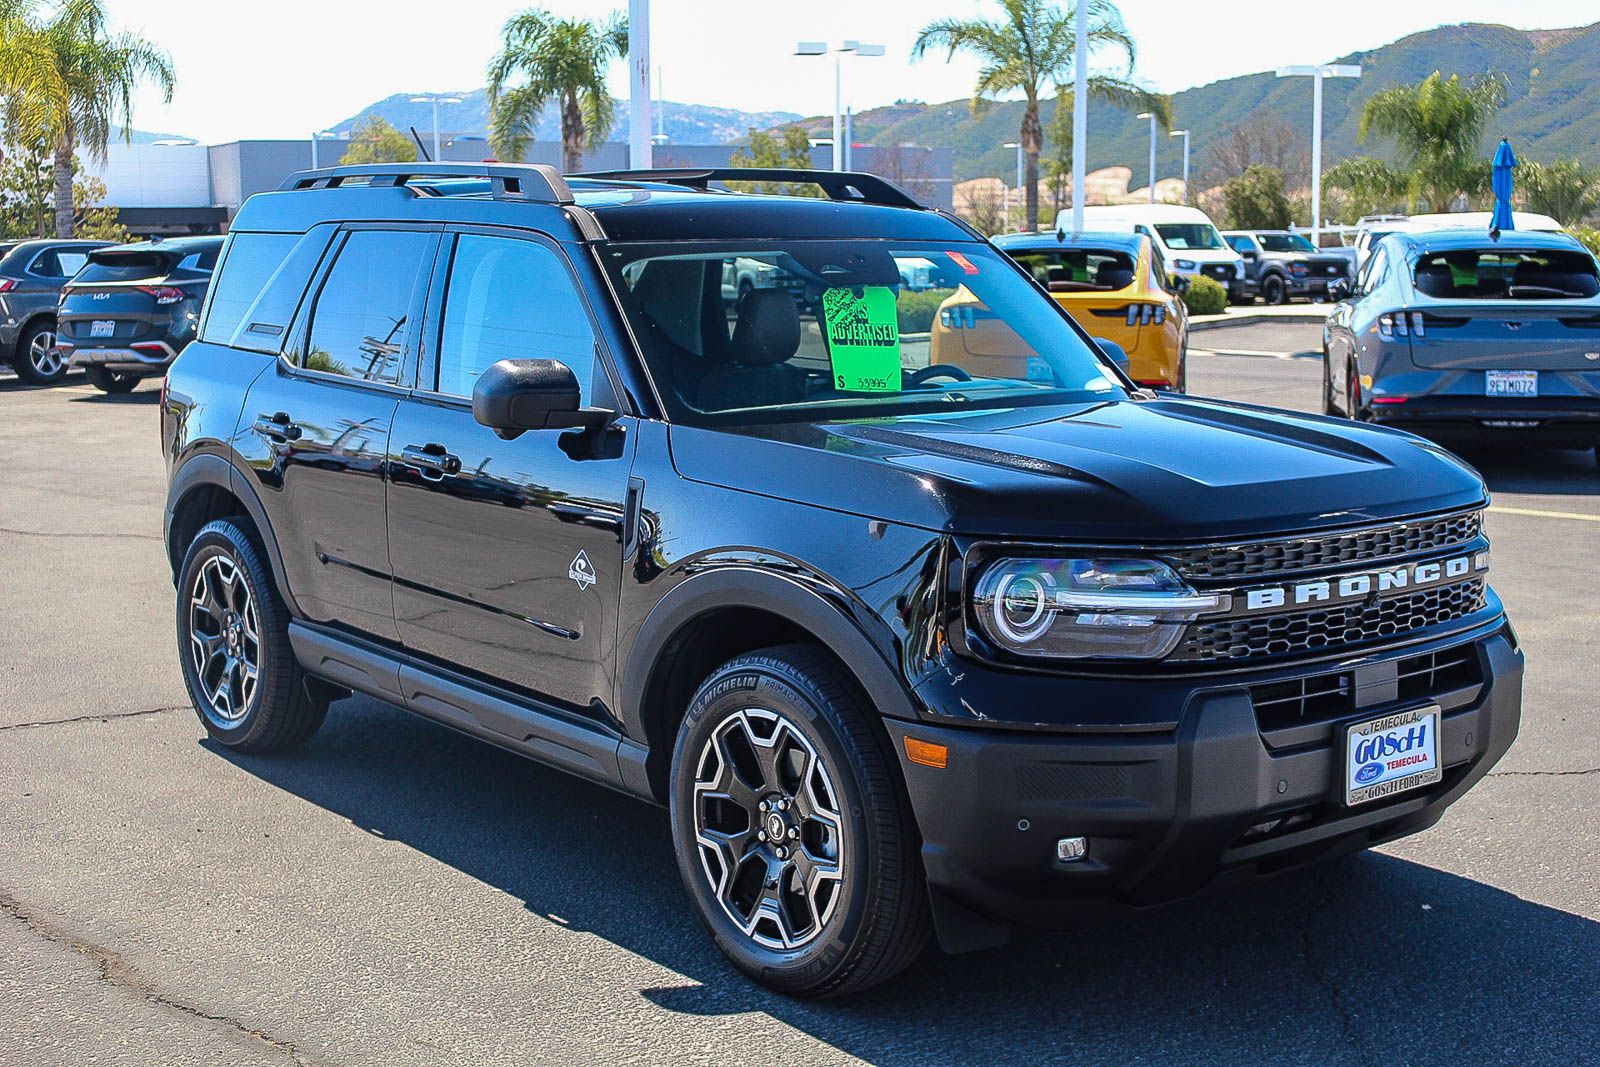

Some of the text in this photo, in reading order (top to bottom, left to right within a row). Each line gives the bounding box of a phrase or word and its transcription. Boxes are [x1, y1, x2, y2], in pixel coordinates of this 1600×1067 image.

[831, 324, 895, 346] ADVERTISED
[1247, 557, 1469, 610] BRONCO
[704, 676, 757, 705] MICHELIN
[1370, 712, 1417, 733] TEMECULA
[1386, 753, 1428, 770] TEMECULA
[1399, 774, 1420, 790] FORD
